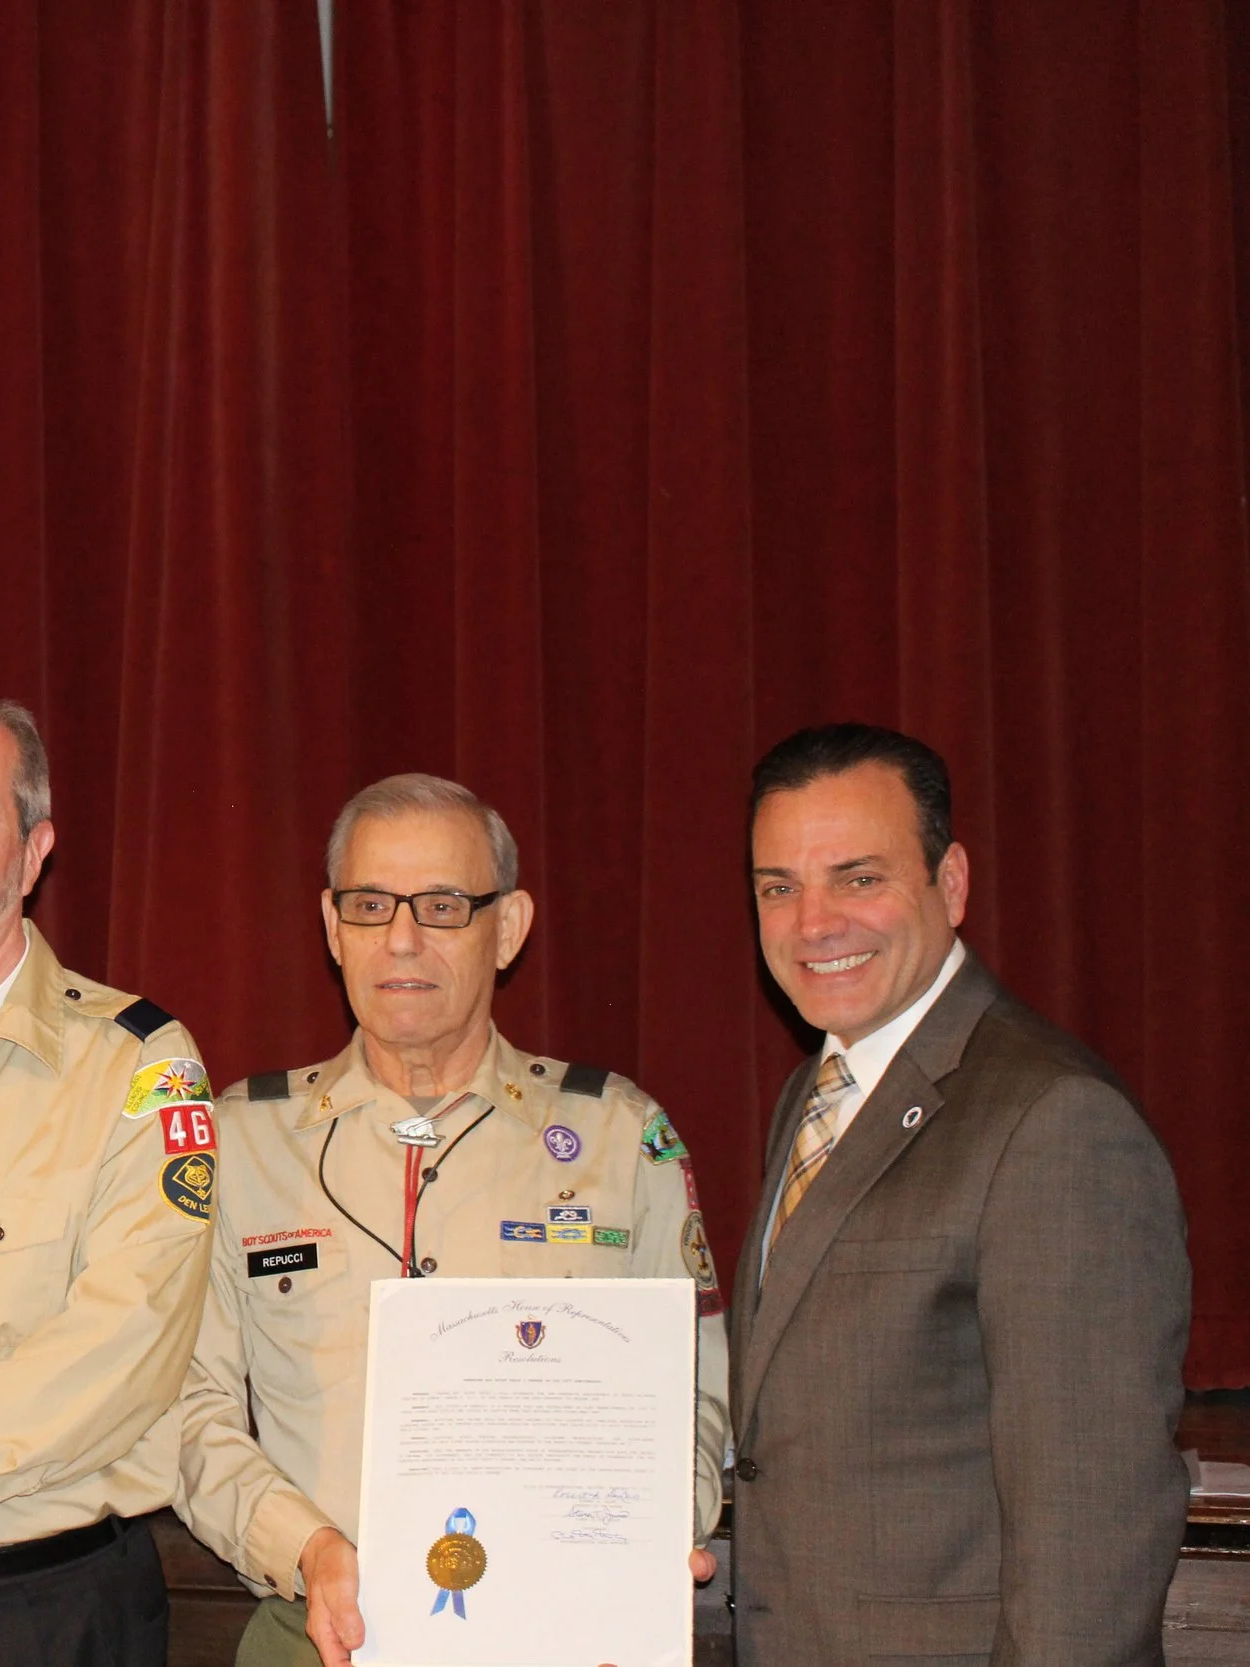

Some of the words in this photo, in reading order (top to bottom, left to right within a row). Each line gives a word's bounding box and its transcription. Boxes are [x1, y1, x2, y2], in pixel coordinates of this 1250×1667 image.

[169, 1110, 210, 1147] 46
[178, 1195, 198, 1211] DEN
[242, 1236, 257, 1247] BOY
[258, 1231, 288, 1245] SCOUTS
[295, 1228, 332, 1239] AMERICA
[262, 1252, 303, 1268] REPUCCI
[429, 1305, 499, 1342] Massachusetts
[502, 1299, 539, 1312] House
[540, 1303, 554, 1315] of
[499, 1350, 562, 1363] Resolutions
